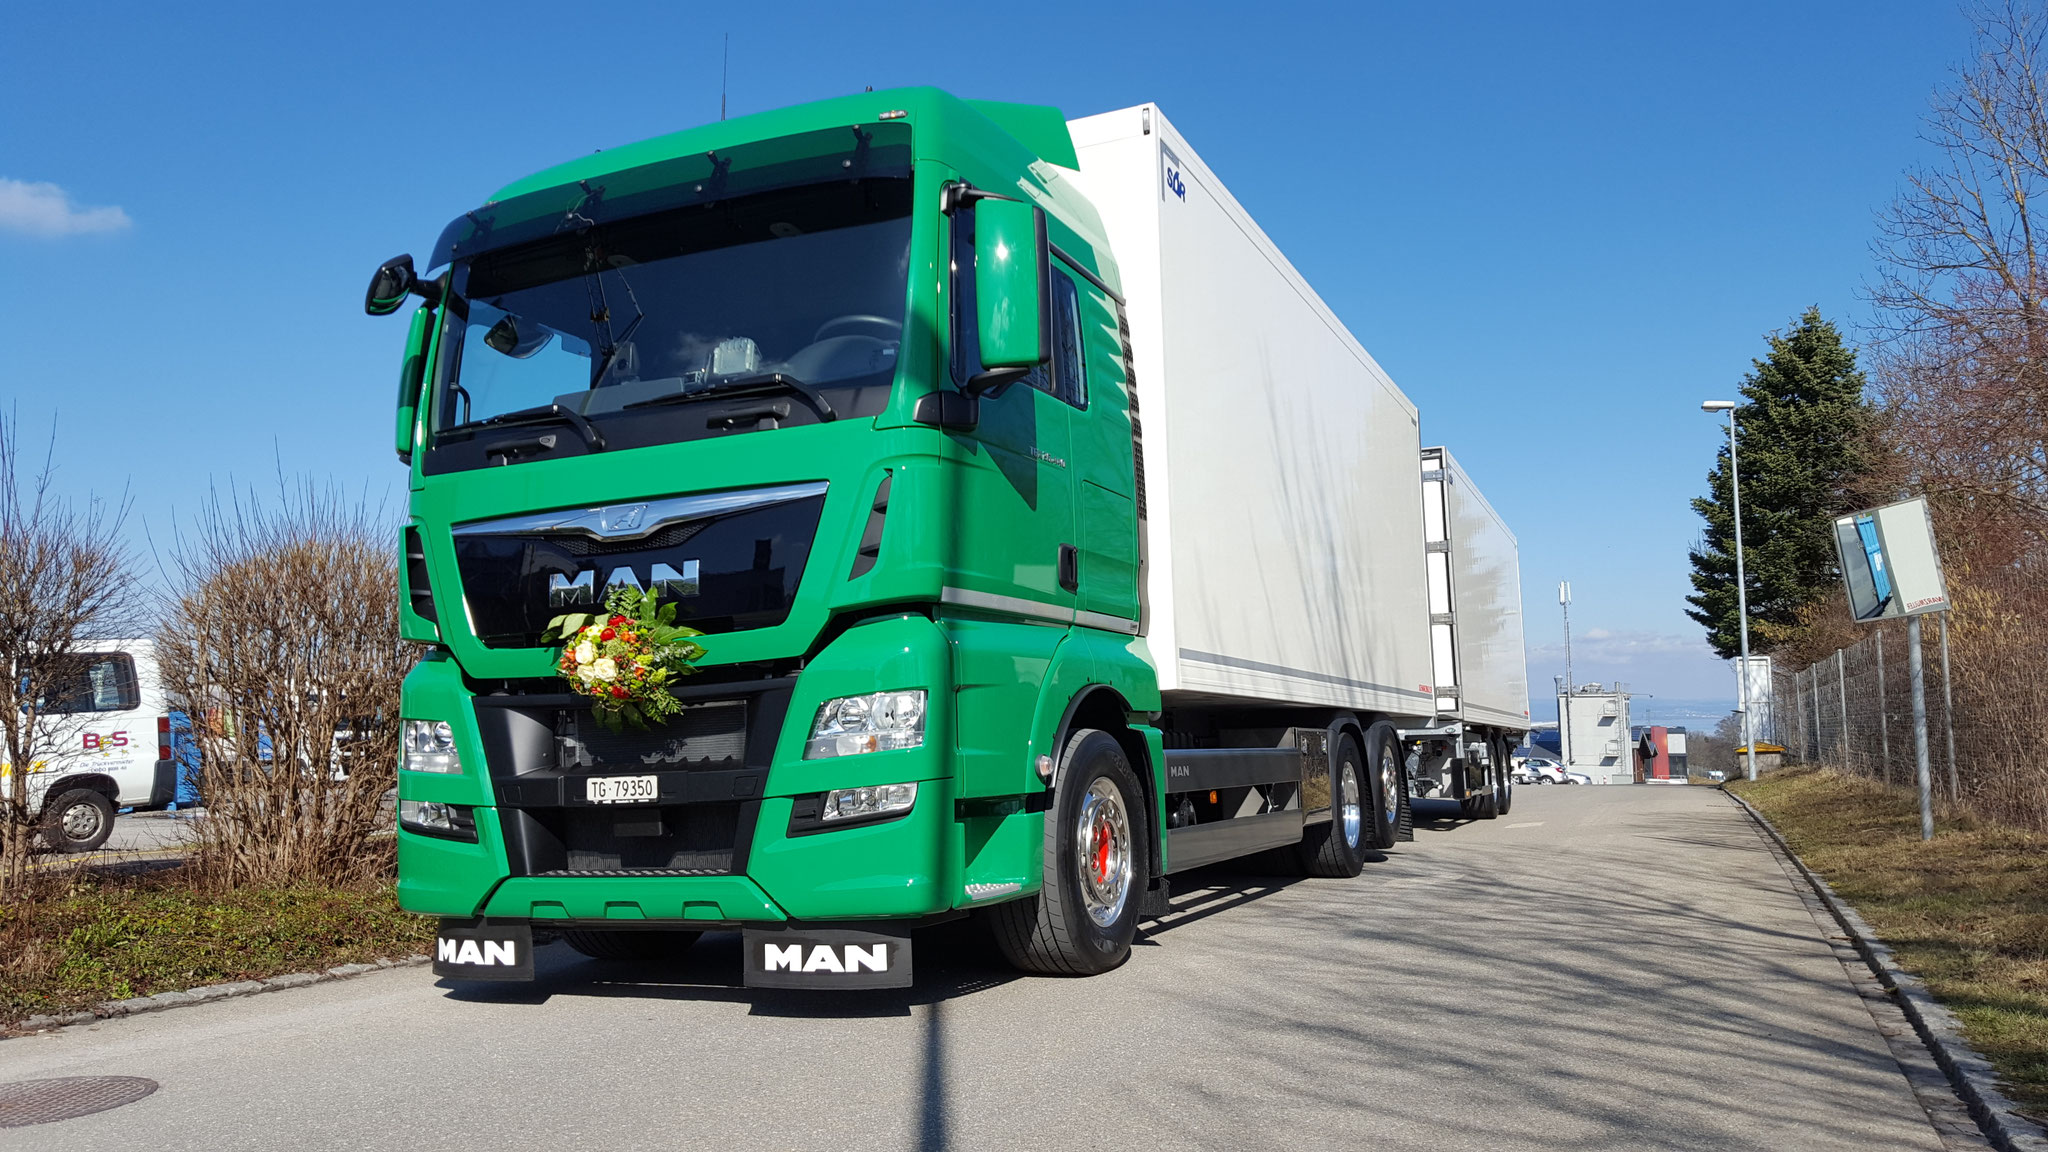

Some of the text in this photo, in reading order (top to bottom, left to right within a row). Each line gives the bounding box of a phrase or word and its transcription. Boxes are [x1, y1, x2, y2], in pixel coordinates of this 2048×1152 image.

[549, 559, 700, 608] MAN
[1170, 765, 1190, 777] MAN
[438, 937, 515, 967] MAN
[764, 943, 888, 973] MAN
